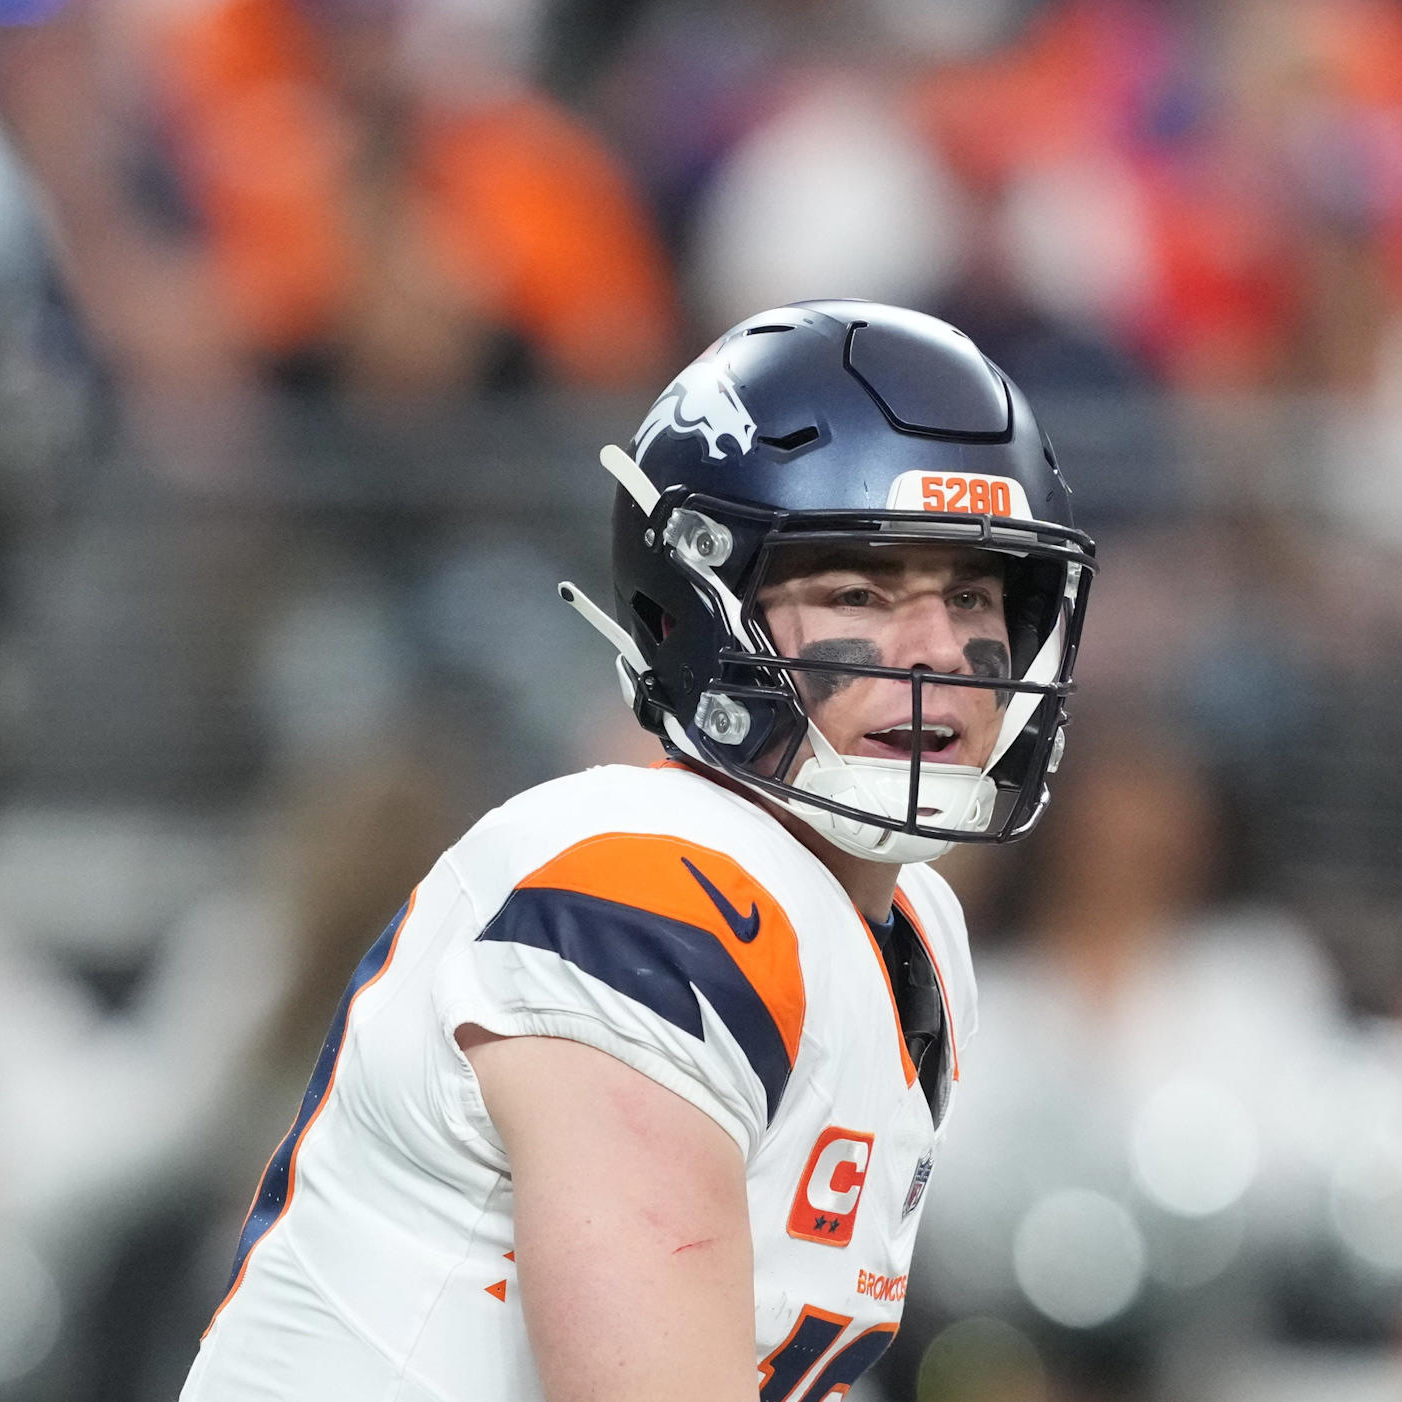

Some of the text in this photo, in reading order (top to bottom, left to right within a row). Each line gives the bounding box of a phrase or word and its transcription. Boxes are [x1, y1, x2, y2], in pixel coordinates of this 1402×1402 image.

[921, 476, 1012, 518] 5280
[806, 1138, 869, 1215] C
[857, 1269, 907, 1302] BRONCOS
